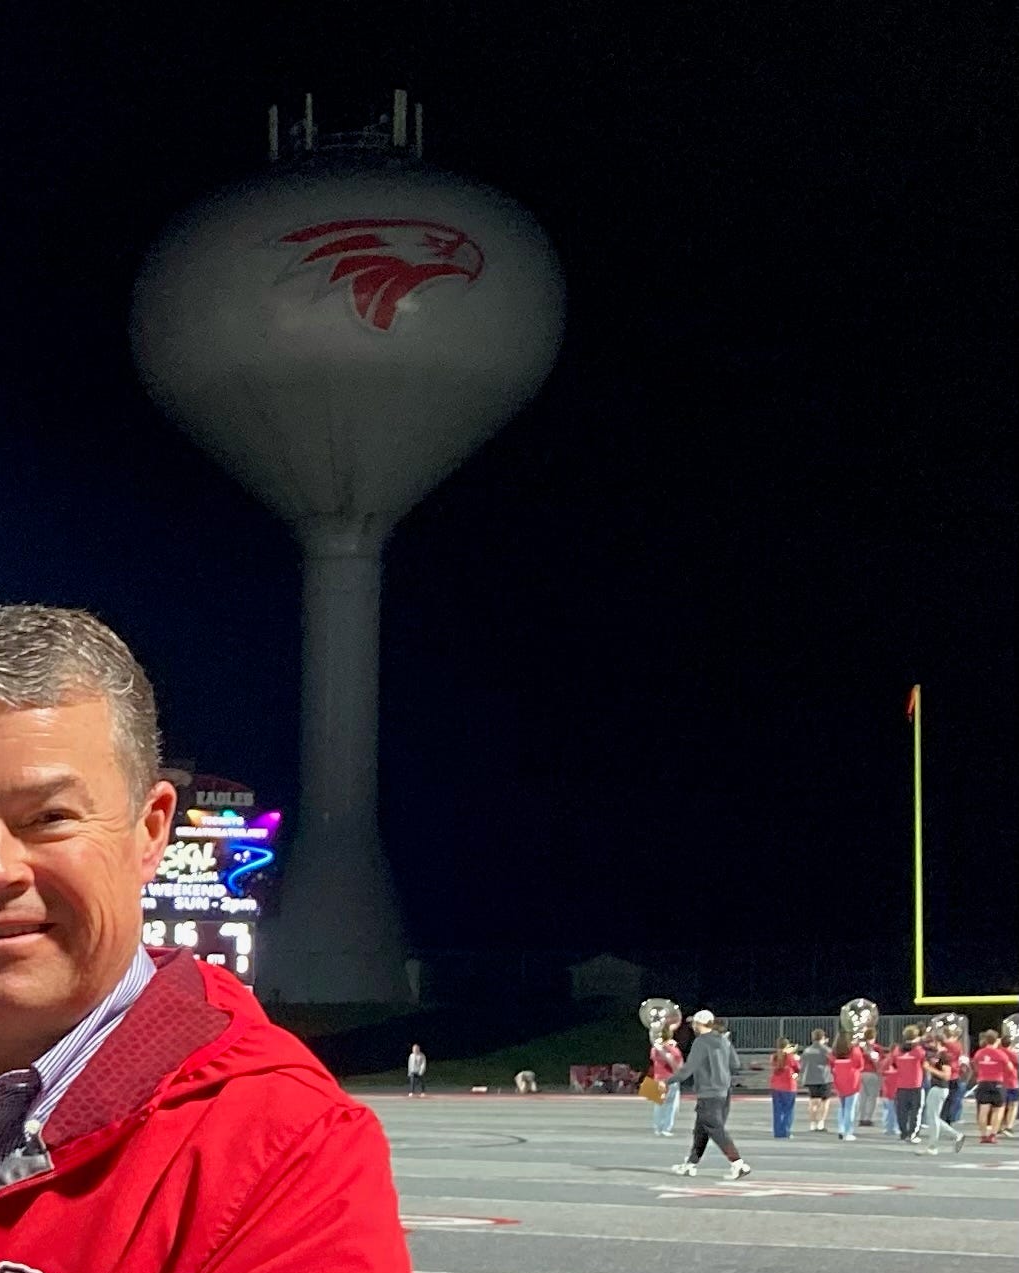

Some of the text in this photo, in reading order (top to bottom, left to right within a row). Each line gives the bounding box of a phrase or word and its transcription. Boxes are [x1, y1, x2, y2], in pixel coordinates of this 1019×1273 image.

[148, 883, 226, 897] WEEKEND
[175, 897, 209, 909] SUN
[221, 897, 257, 913] 2pm
